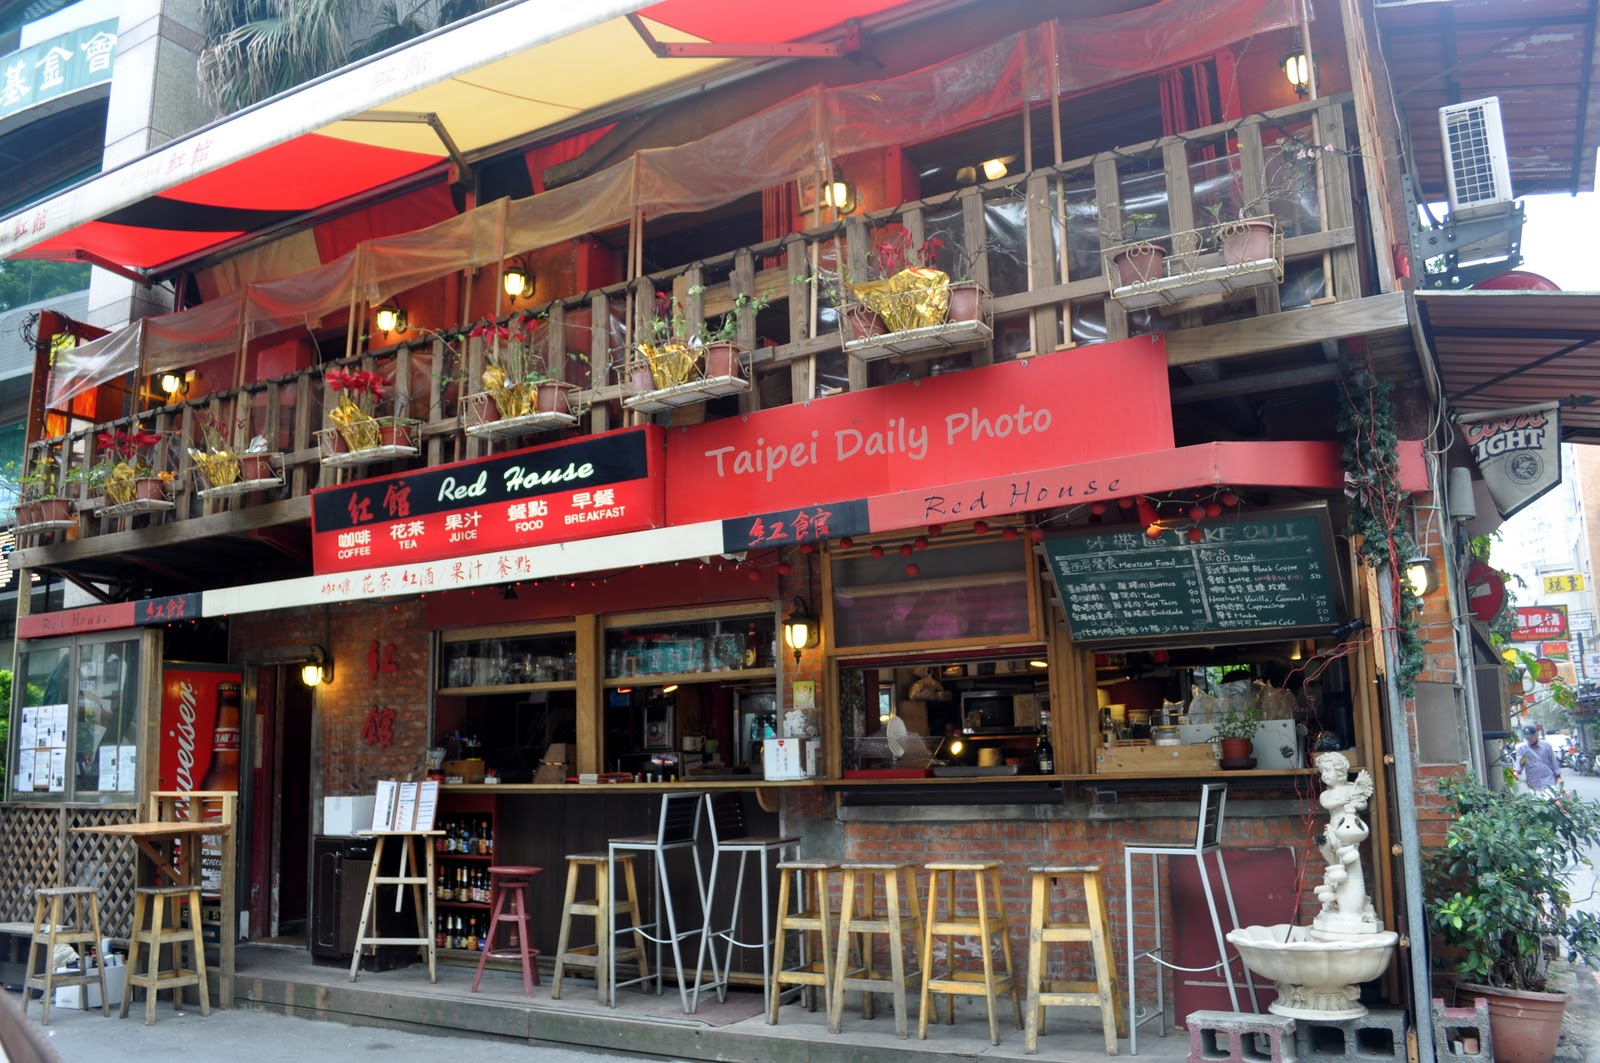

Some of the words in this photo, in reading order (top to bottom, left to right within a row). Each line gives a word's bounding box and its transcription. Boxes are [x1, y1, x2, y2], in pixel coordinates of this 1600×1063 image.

[0, 31, 118, 107] 基金會
[1471, 429, 1544, 463] IGHT
[437, 470, 488, 502] Red
[503, 462, 594, 492] House
[571, 488, 614, 510] 早餐
[923, 494, 989, 520] Red
[1010, 477, 1122, 507] House
[507, 500, 548, 522] 餐點
[564, 506, 626, 525] BREAKFAST
[445, 512, 482, 533] 果汁
[515, 520, 544, 532] FOOD
[747, 508, 833, 547] 紅館
[390, 521, 425, 540] 花茶
[449, 529, 478, 542] JUICE
[1175, 527, 1233, 545] TKE
[338, 530, 371, 549] 咖啡
[398, 539, 418, 551] TEA
[338, 546, 371, 559] COFFEE
[1234, 553, 1256, 562] Drink
[1119, 561, 1153, 569] Mexican
[1155, 558, 1176, 567] Food
[1252, 564, 1273, 572] Black
[1275, 564, 1298, 572] Coffee
[1186, 580, 1196, 588] 90
[1228, 576, 1252, 584] Latte
[1188, 589, 1199, 597] 90
[1190, 598, 1200, 606] 90
[42, 618, 65, 631] Red
